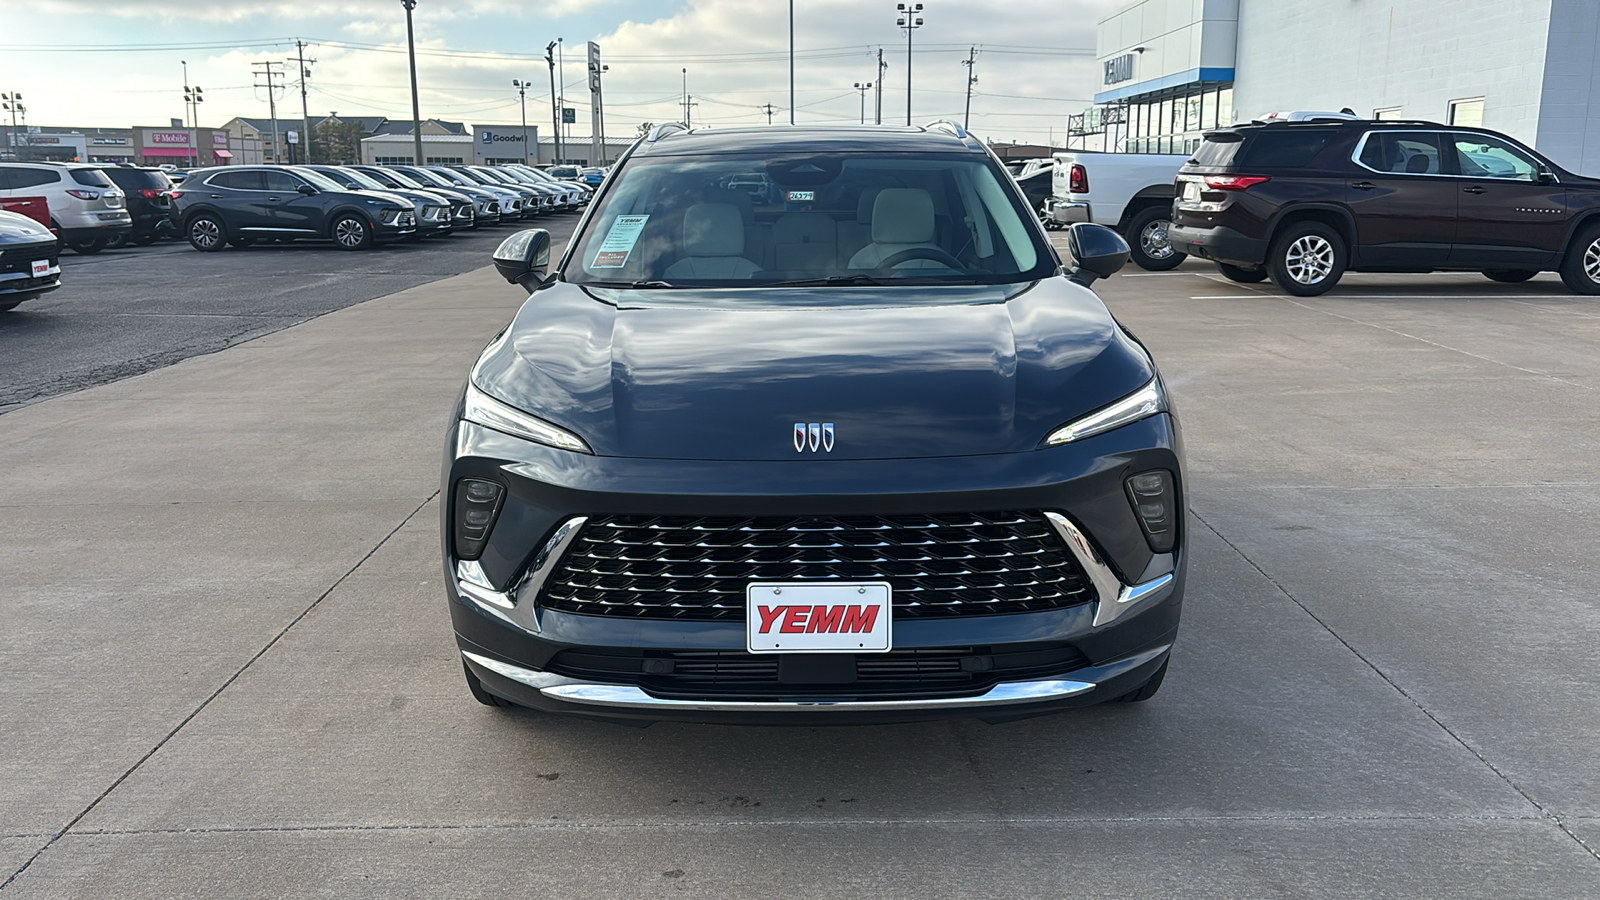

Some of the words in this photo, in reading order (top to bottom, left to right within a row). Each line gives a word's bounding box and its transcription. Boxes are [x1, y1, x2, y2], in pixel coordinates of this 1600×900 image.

[161, 134, 187, 142] Mobile
[493, 134, 528, 142] Goodwil
[757, 605, 881, 634] YEMM
